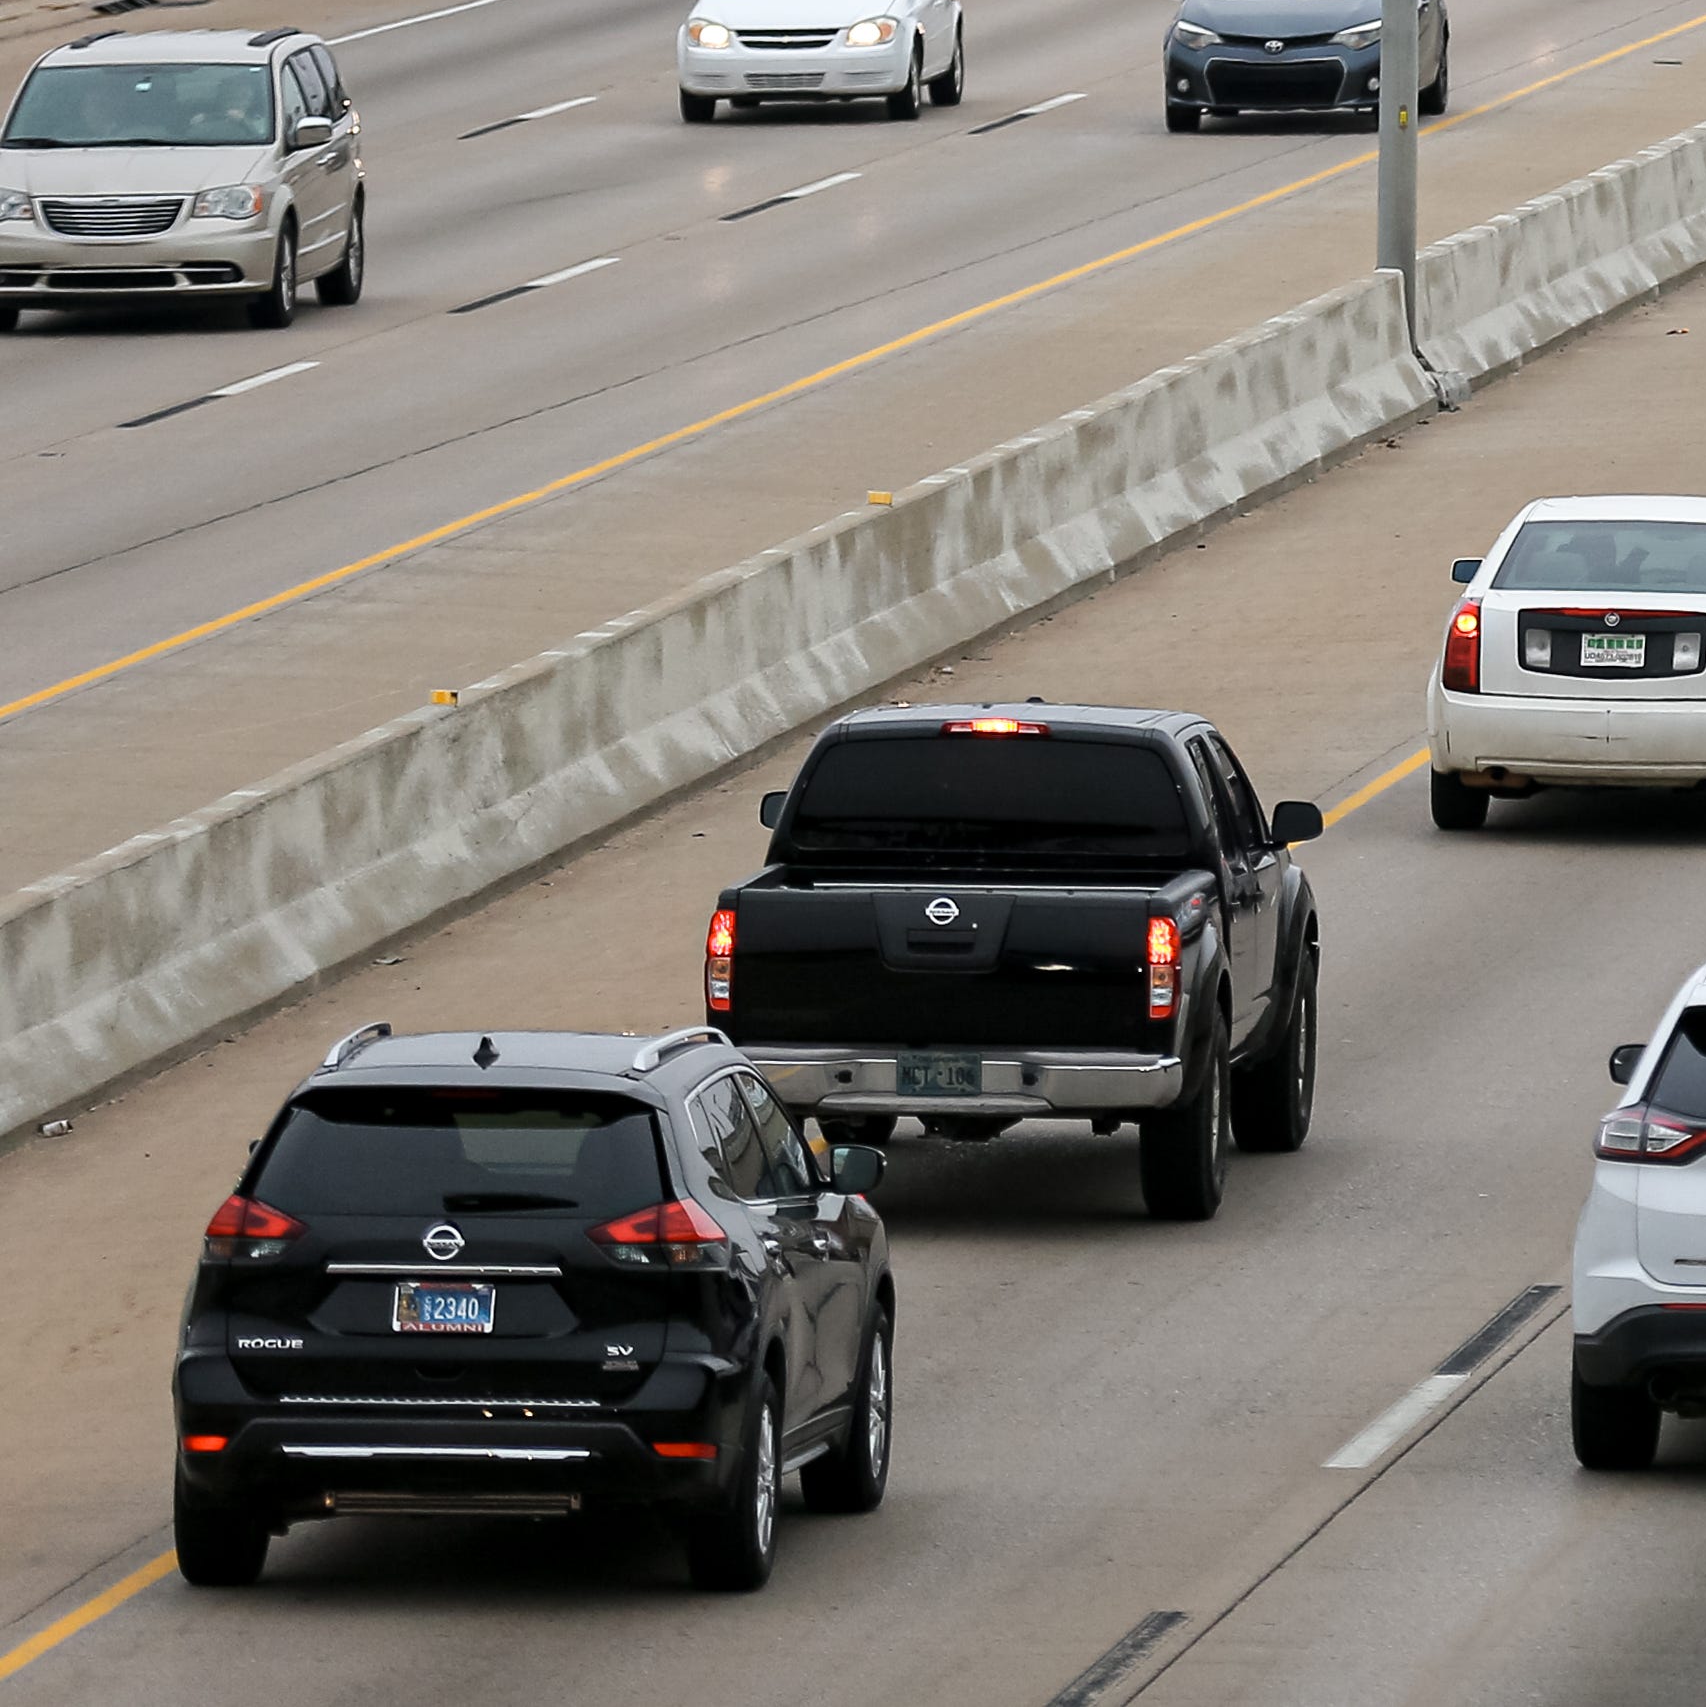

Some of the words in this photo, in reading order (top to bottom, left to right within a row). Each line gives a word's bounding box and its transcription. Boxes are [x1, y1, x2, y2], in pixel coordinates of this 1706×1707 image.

[434, 1297, 479, 1320] 2340
[402, 1323, 483, 1332] ALUMNI
[238, 1339, 304, 1350] ROGUE
[607, 1345, 634, 1357] SV
